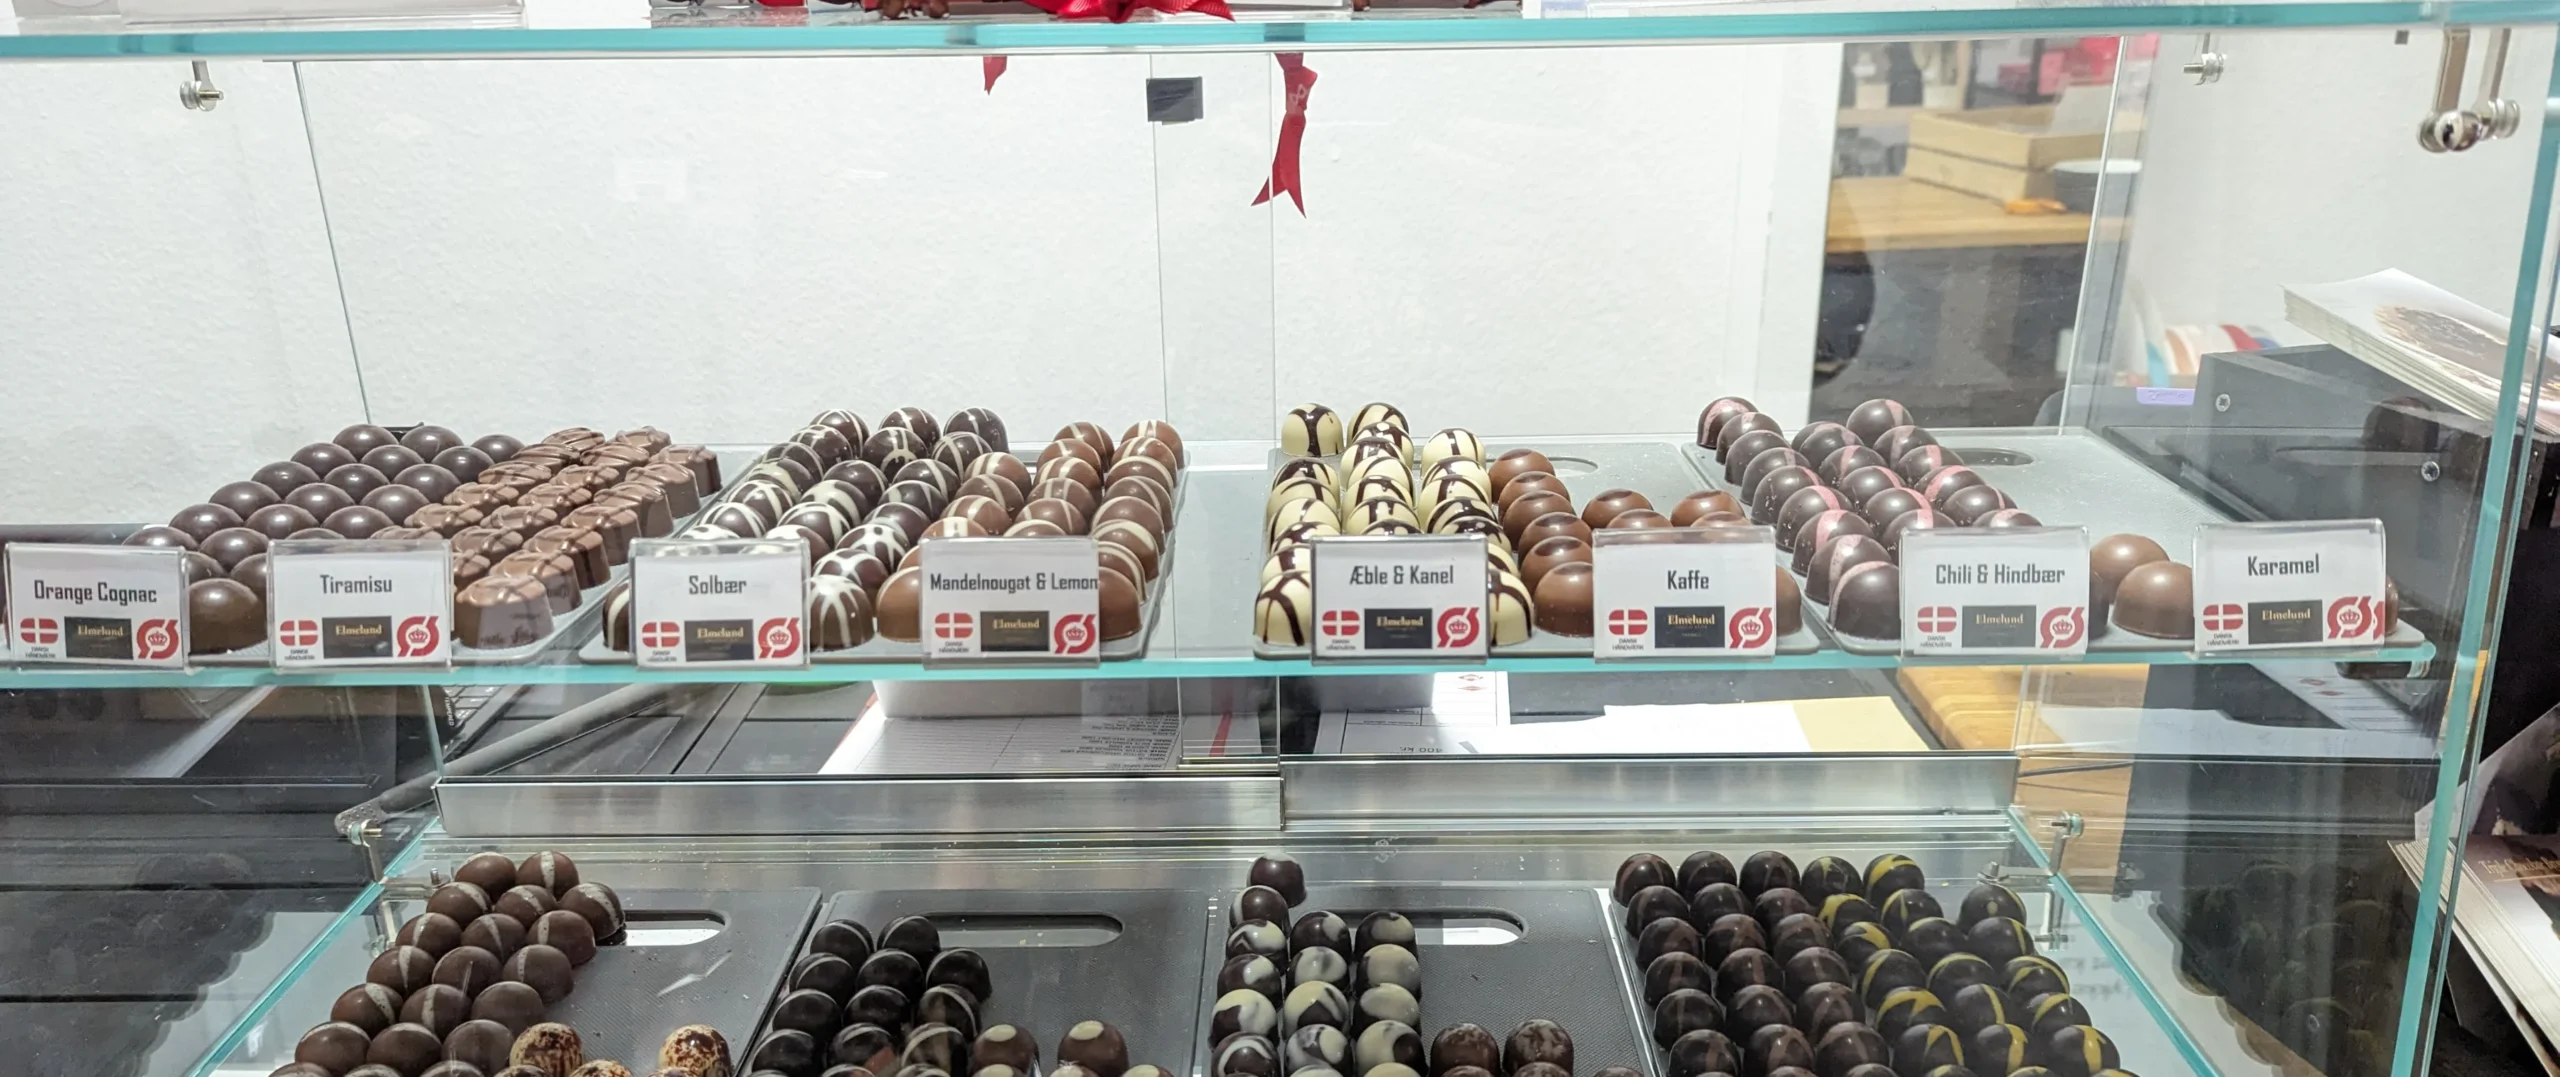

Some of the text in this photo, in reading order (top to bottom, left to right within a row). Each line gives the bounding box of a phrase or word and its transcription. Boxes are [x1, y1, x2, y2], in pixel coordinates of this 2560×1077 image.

[1349, 564, 1455, 585] Æble & Kanel
[1935, 563, 2066, 584] Chili & Hindbær
[2248, 553, 2320, 576] Karamel
[319, 574, 393, 594] Tiramisu
[688, 575, 747, 595] Solbær
[930, 572, 1098, 594] Mandelnougat & Lemon
[1667, 570, 1710, 590] Kaffe
[34, 579, 157, 607] Orange Cognac
[993, 618, 1040, 629] Elmelund
[1668, 613, 1715, 625] Elmelund
[1976, 613, 2024, 625] Elmelund
[2261, 608, 2311, 621] Elmelund
[335, 624, 382, 635] Elmelund
